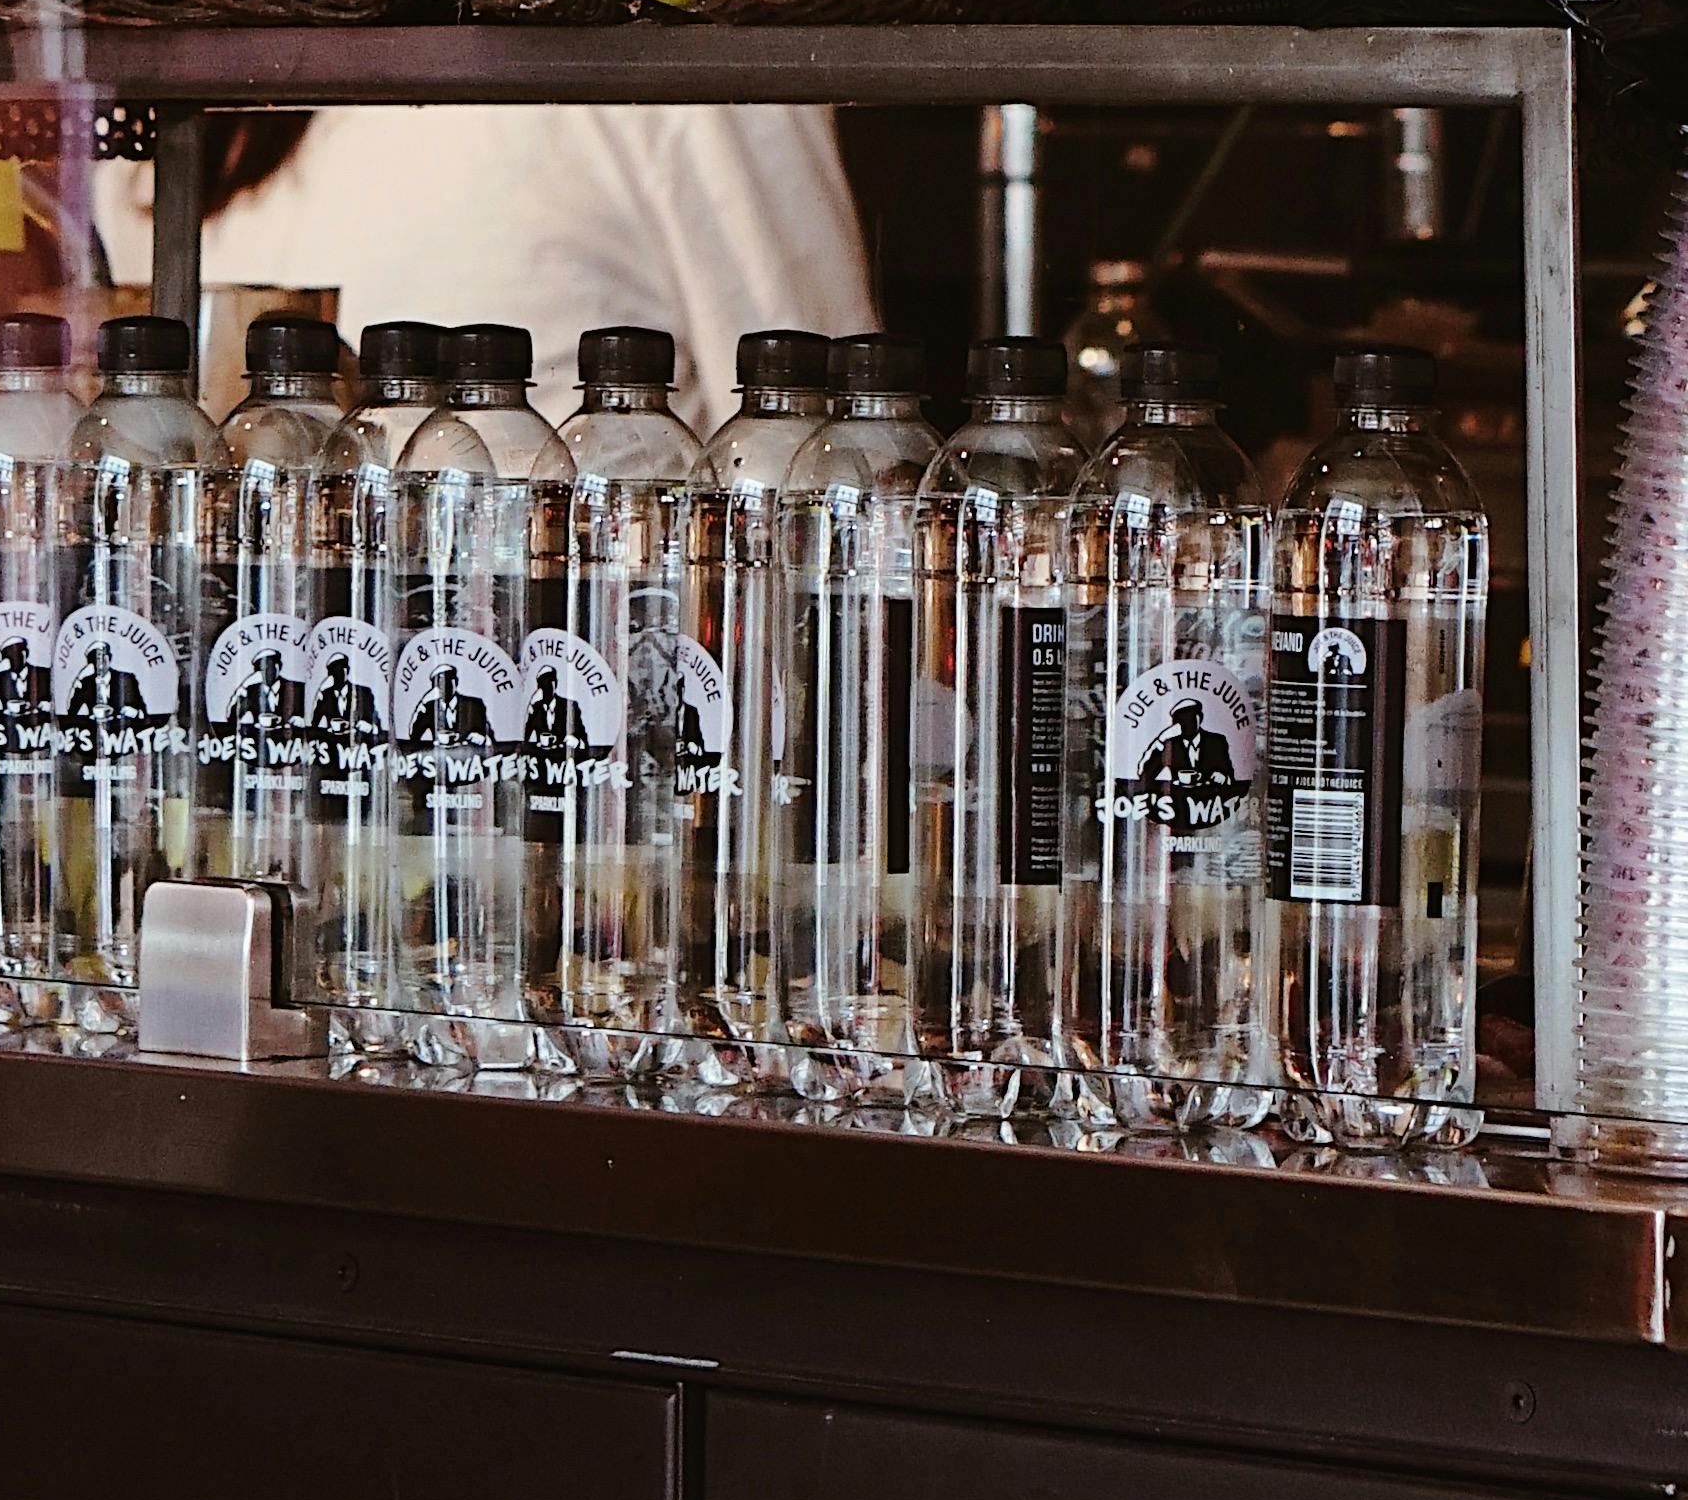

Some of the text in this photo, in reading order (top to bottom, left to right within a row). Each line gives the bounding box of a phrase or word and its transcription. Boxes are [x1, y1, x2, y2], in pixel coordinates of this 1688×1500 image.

[0, 611, 37, 629] THE
[328, 627, 357, 645] THE
[55, 635, 75, 669] JOE
[73, 622, 85, 639] &
[85, 615, 118, 634] THE
[120, 624, 165, 668] JUICE
[215, 623, 290, 676] JOE & THE
[1032, 648, 1054, 666] 0.5
[397, 658, 419, 692] JOE
[417, 645, 430, 662] &
[430, 638, 466, 656] THE
[468, 647, 514, 694] JUICE
[537, 639, 565, 658] THE
[566, 648, 609, 697] JUICE
[690, 655, 721, 704] JUICE
[1124, 690, 1154, 729] JOE
[1153, 678, 1171, 696] &
[1173, 670, 1212, 690] THE
[1213, 680, 1249, 730] JUICE
[101, 724, 191, 756] WATER
[336, 743, 390, 772] WAT
[446, 752, 519, 784] WATE
[545, 757, 633, 790] WATER
[677, 764, 743, 797] WATER
[1296, 775, 1364, 790] #JOEADTHEJUICE
[529, 795, 568, 812] SPARKLIN
[1095, 792, 1176, 824] JOE'S
[1161, 836, 1223, 853] SPARKLING
